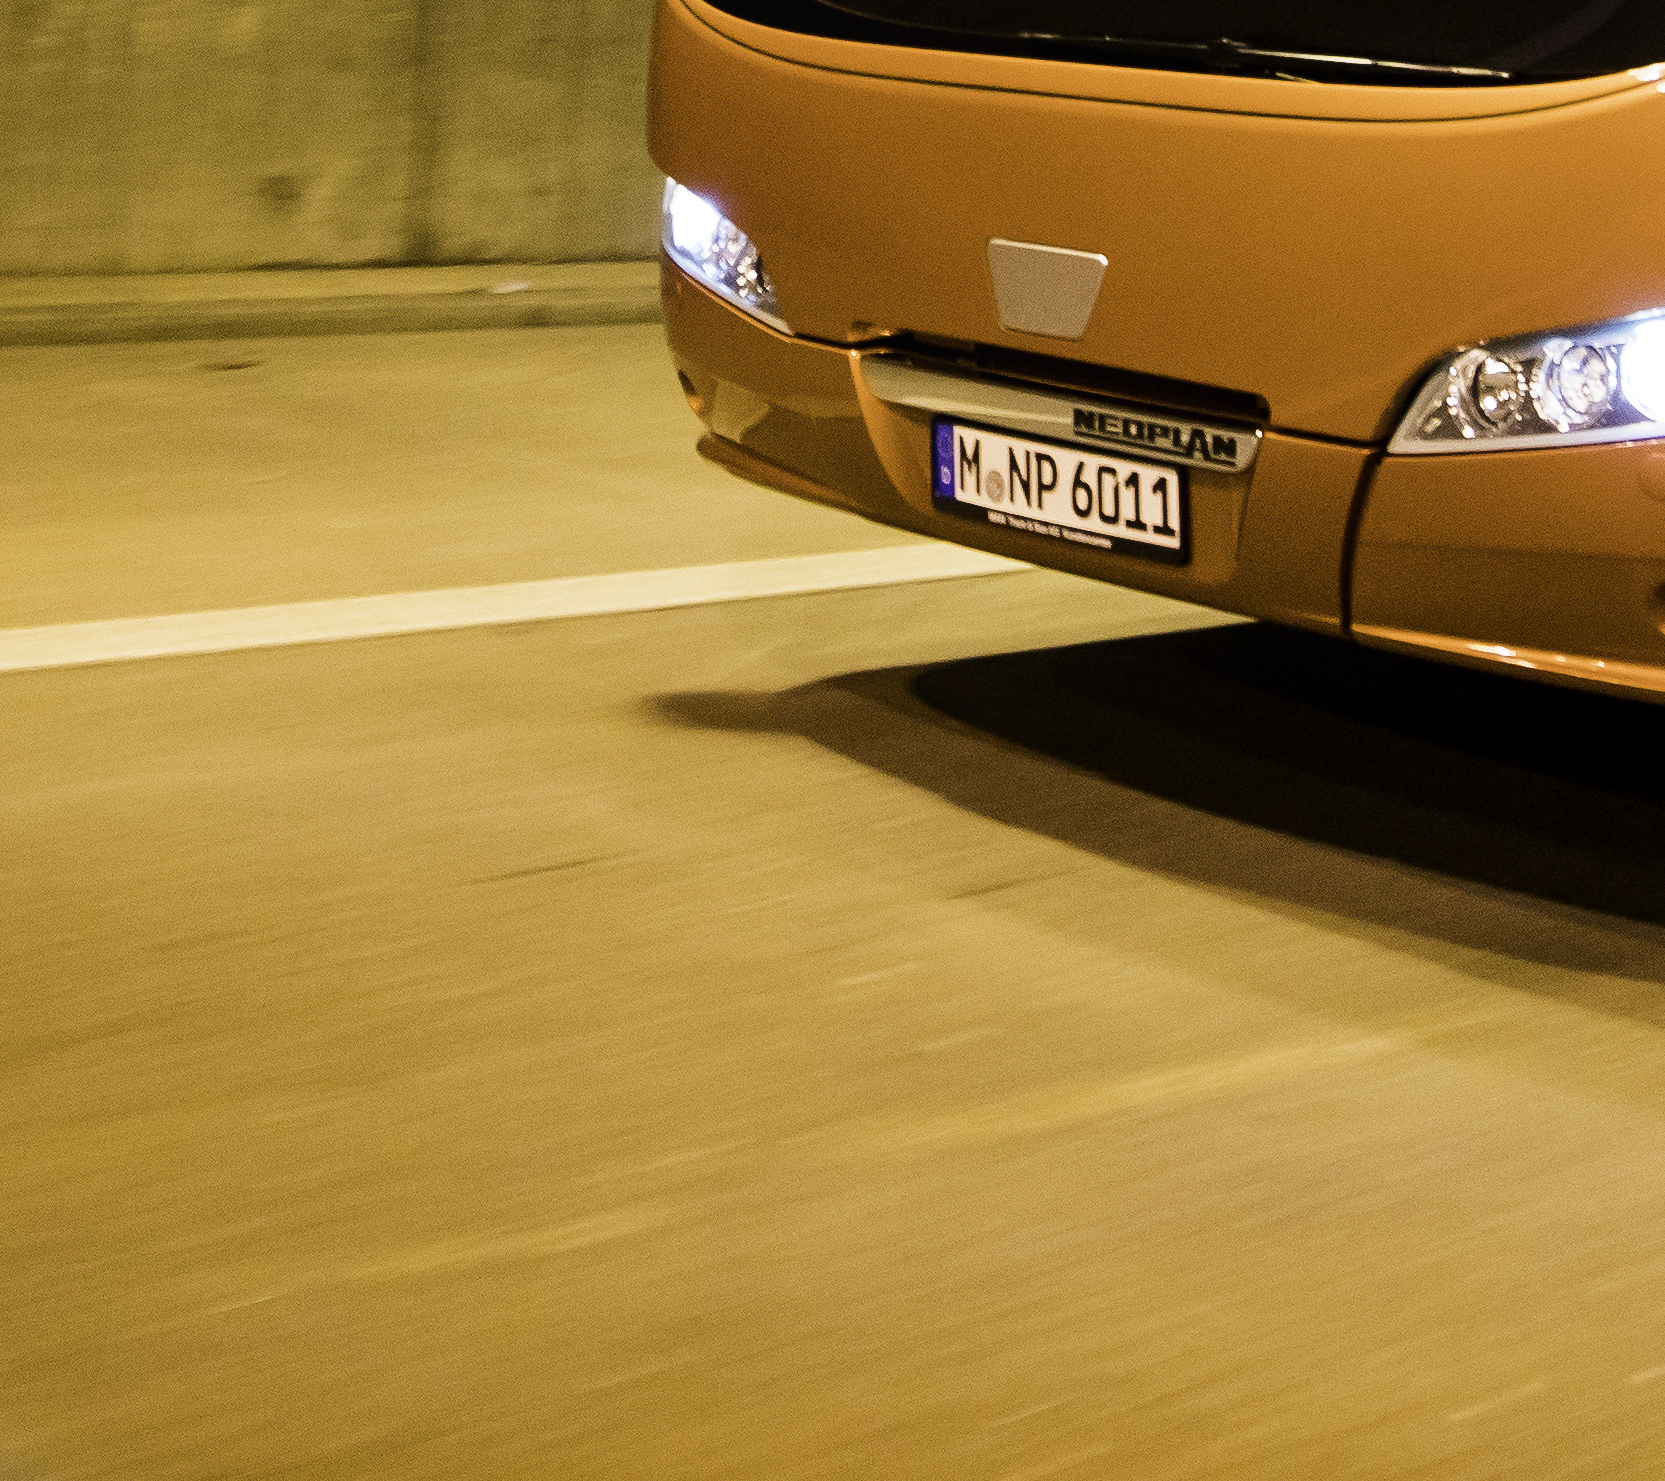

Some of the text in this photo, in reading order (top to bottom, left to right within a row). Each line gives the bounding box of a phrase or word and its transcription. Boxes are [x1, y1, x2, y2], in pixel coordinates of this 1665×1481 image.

[1073, 408, 1236, 463] NEOPLAN
[959, 435, 981, 496] M
[1009, 447, 1058, 510] NP
[1072, 461, 1176, 537] 6011
